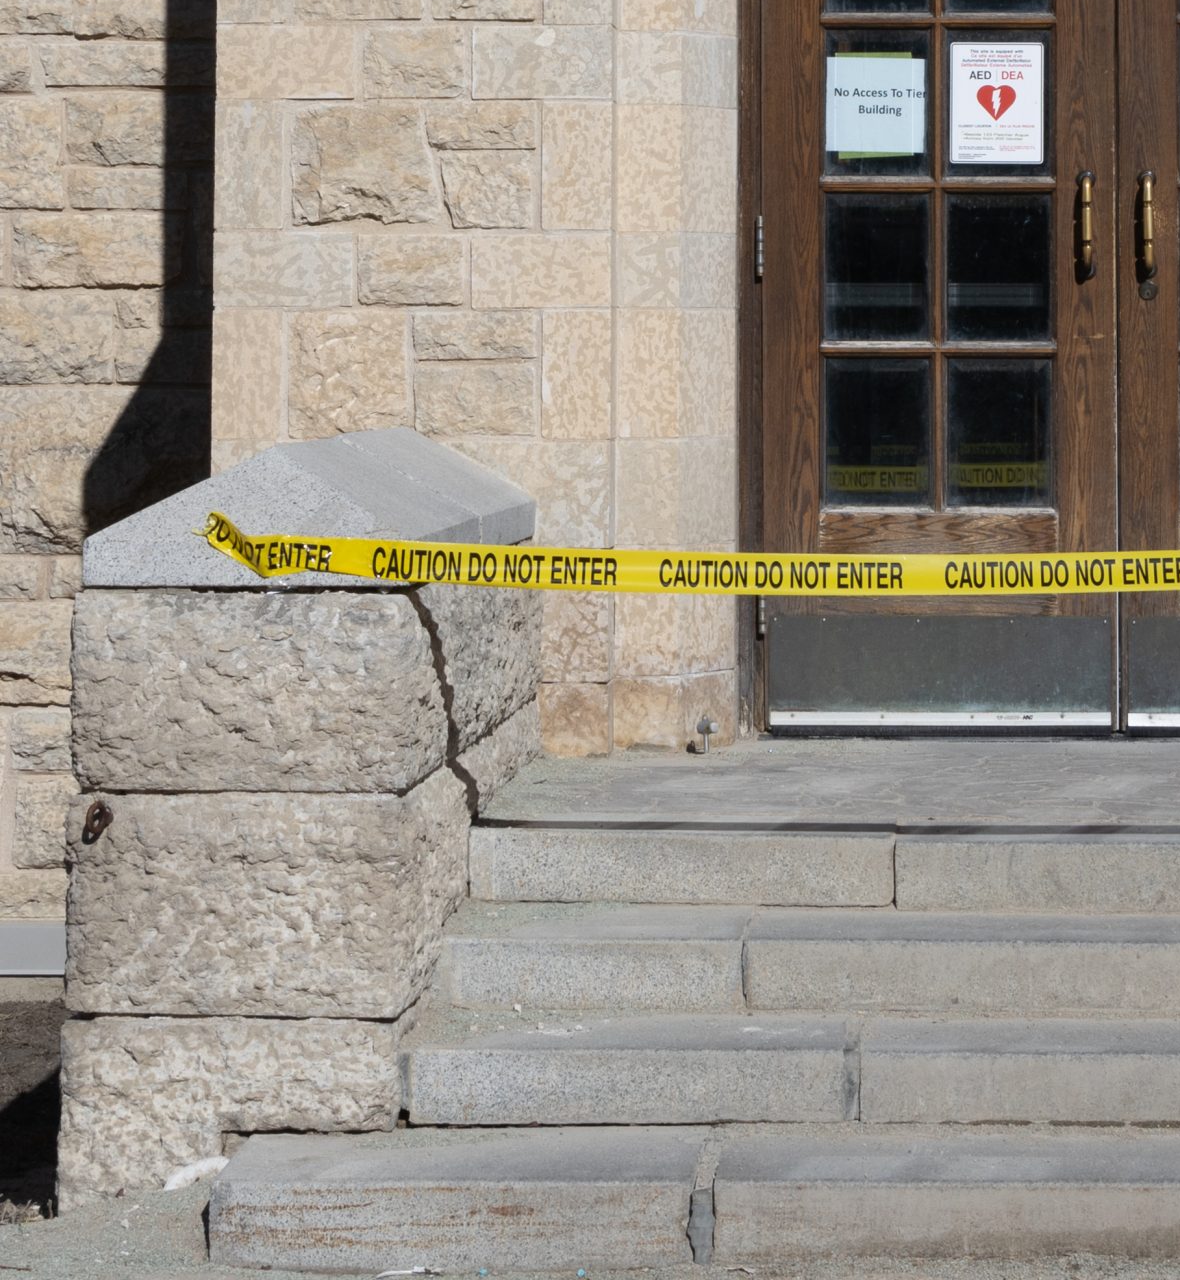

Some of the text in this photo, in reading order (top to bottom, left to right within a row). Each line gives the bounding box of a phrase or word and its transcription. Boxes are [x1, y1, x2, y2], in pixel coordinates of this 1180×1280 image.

[969, 70, 1024, 80] AED DEA
[834, 87, 928, 99] No Access To Tier
[858, 105, 902, 117] Building
[268, 541, 333, 572] ENTER
[372, 546, 618, 586] CAUTION DO NOT ENTER
[659, 558, 903, 589] CAUTION DO NOT ENTER
[944, 560, 1033, 589] CAUTION
[1040, 560, 1069, 587] DO
[1075, 558, 1116, 586] NOT
